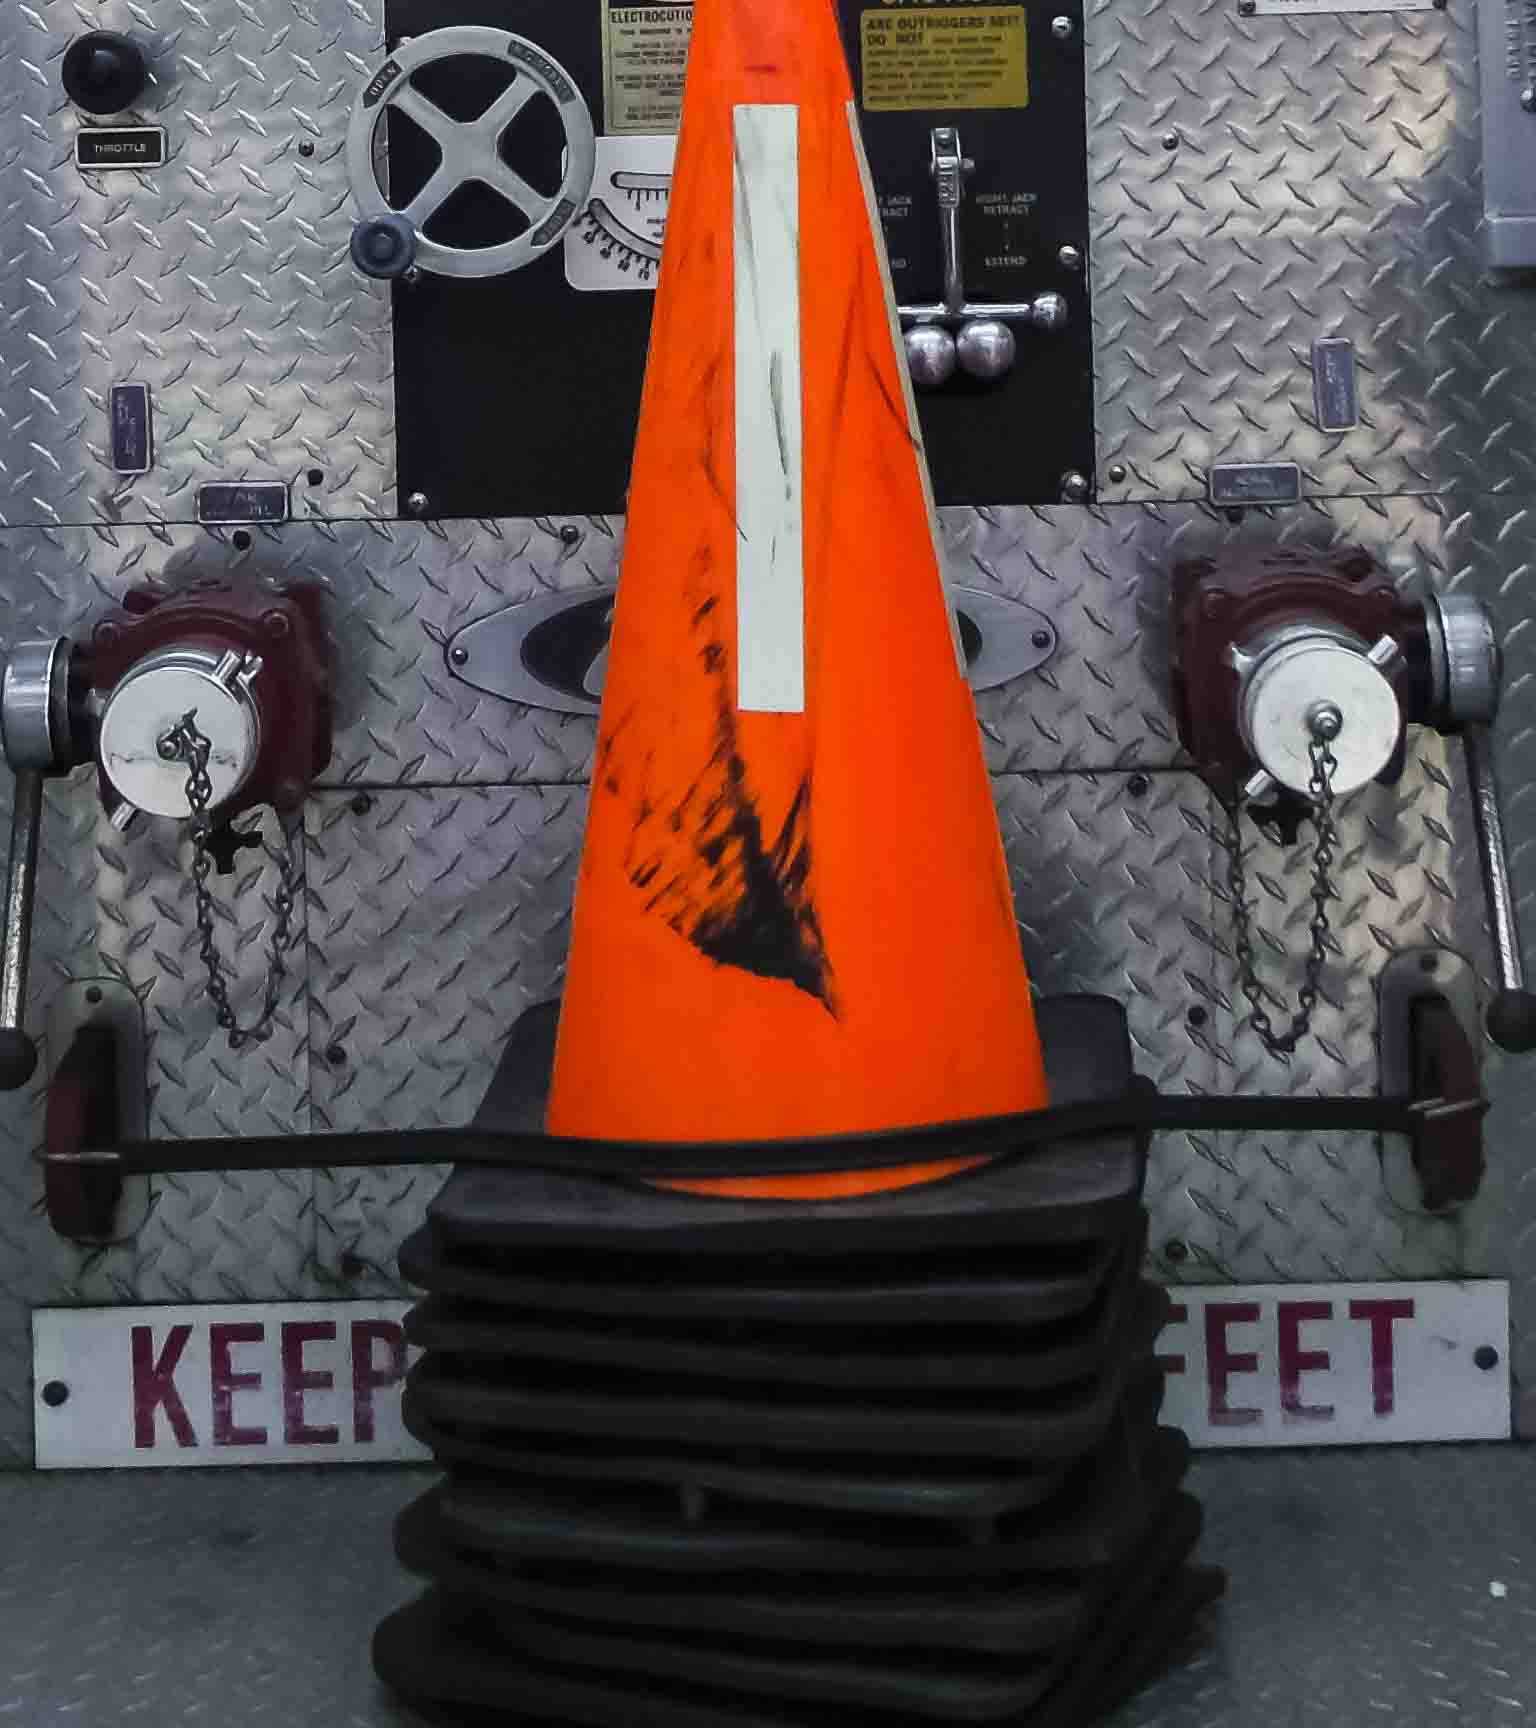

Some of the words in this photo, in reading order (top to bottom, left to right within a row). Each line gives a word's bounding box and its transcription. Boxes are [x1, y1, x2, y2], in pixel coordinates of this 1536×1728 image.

[611, 9, 693, 24] ELECTROCUTIO
[867, 34, 887, 47] DO
[896, 32, 923, 44] NOT
[983, 206, 1030, 217] RETRACT
[984, 256, 1029, 267] EXTEND
[130, 1320, 408, 1449] KEEP
